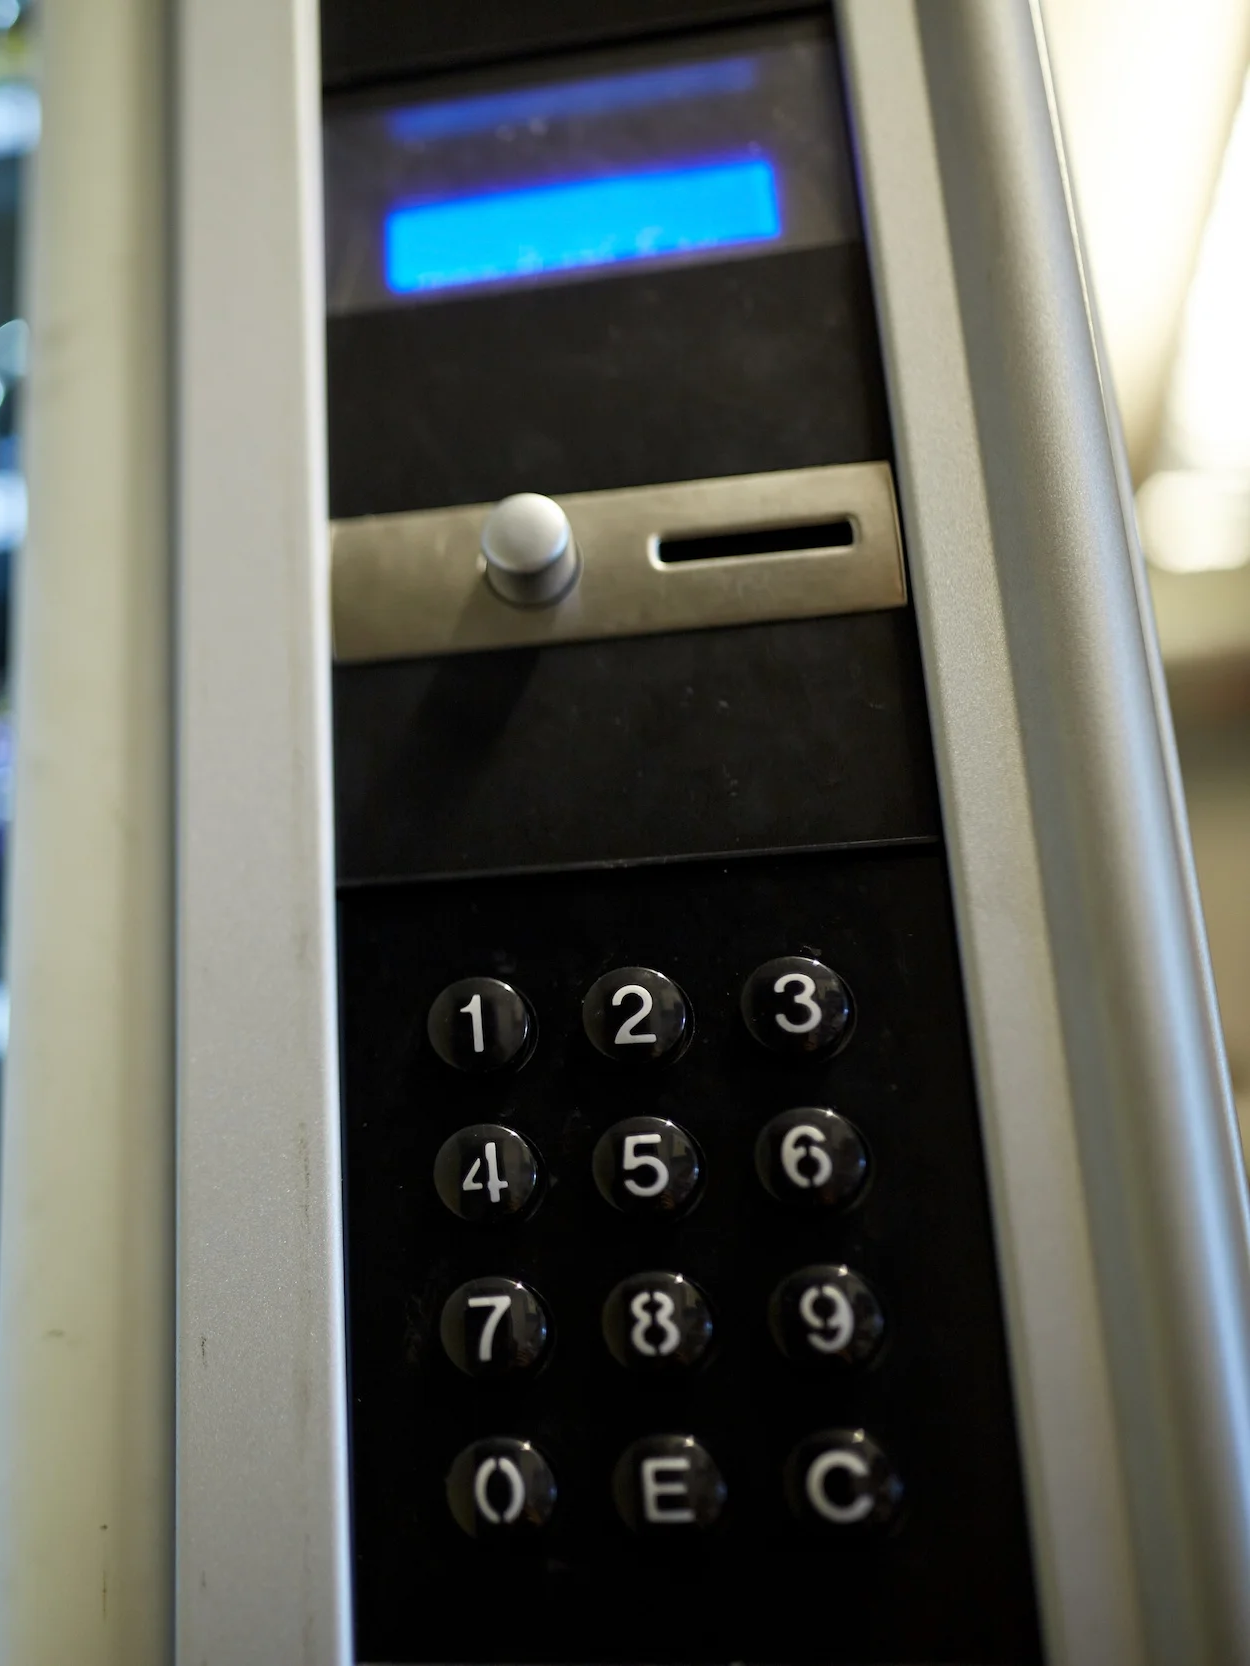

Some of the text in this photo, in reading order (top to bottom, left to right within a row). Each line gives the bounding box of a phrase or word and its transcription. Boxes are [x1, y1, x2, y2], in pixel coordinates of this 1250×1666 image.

[460, 994, 484, 1052] 1
[612, 984, 657, 1044] 2
[774, 973, 822, 1033] 3
[463, 1142, 508, 1202] 4
[623, 1133, 669, 1196] 5
[782, 1125, 832, 1187] 6
[468, 1295, 511, 1360] 7
[631, 1291, 680, 1354] 8
[800, 1284, 853, 1353] 9
[475, 1457, 525, 1521] 0
[643, 1457, 691, 1520] E
[809, 1450, 871, 1521] C
